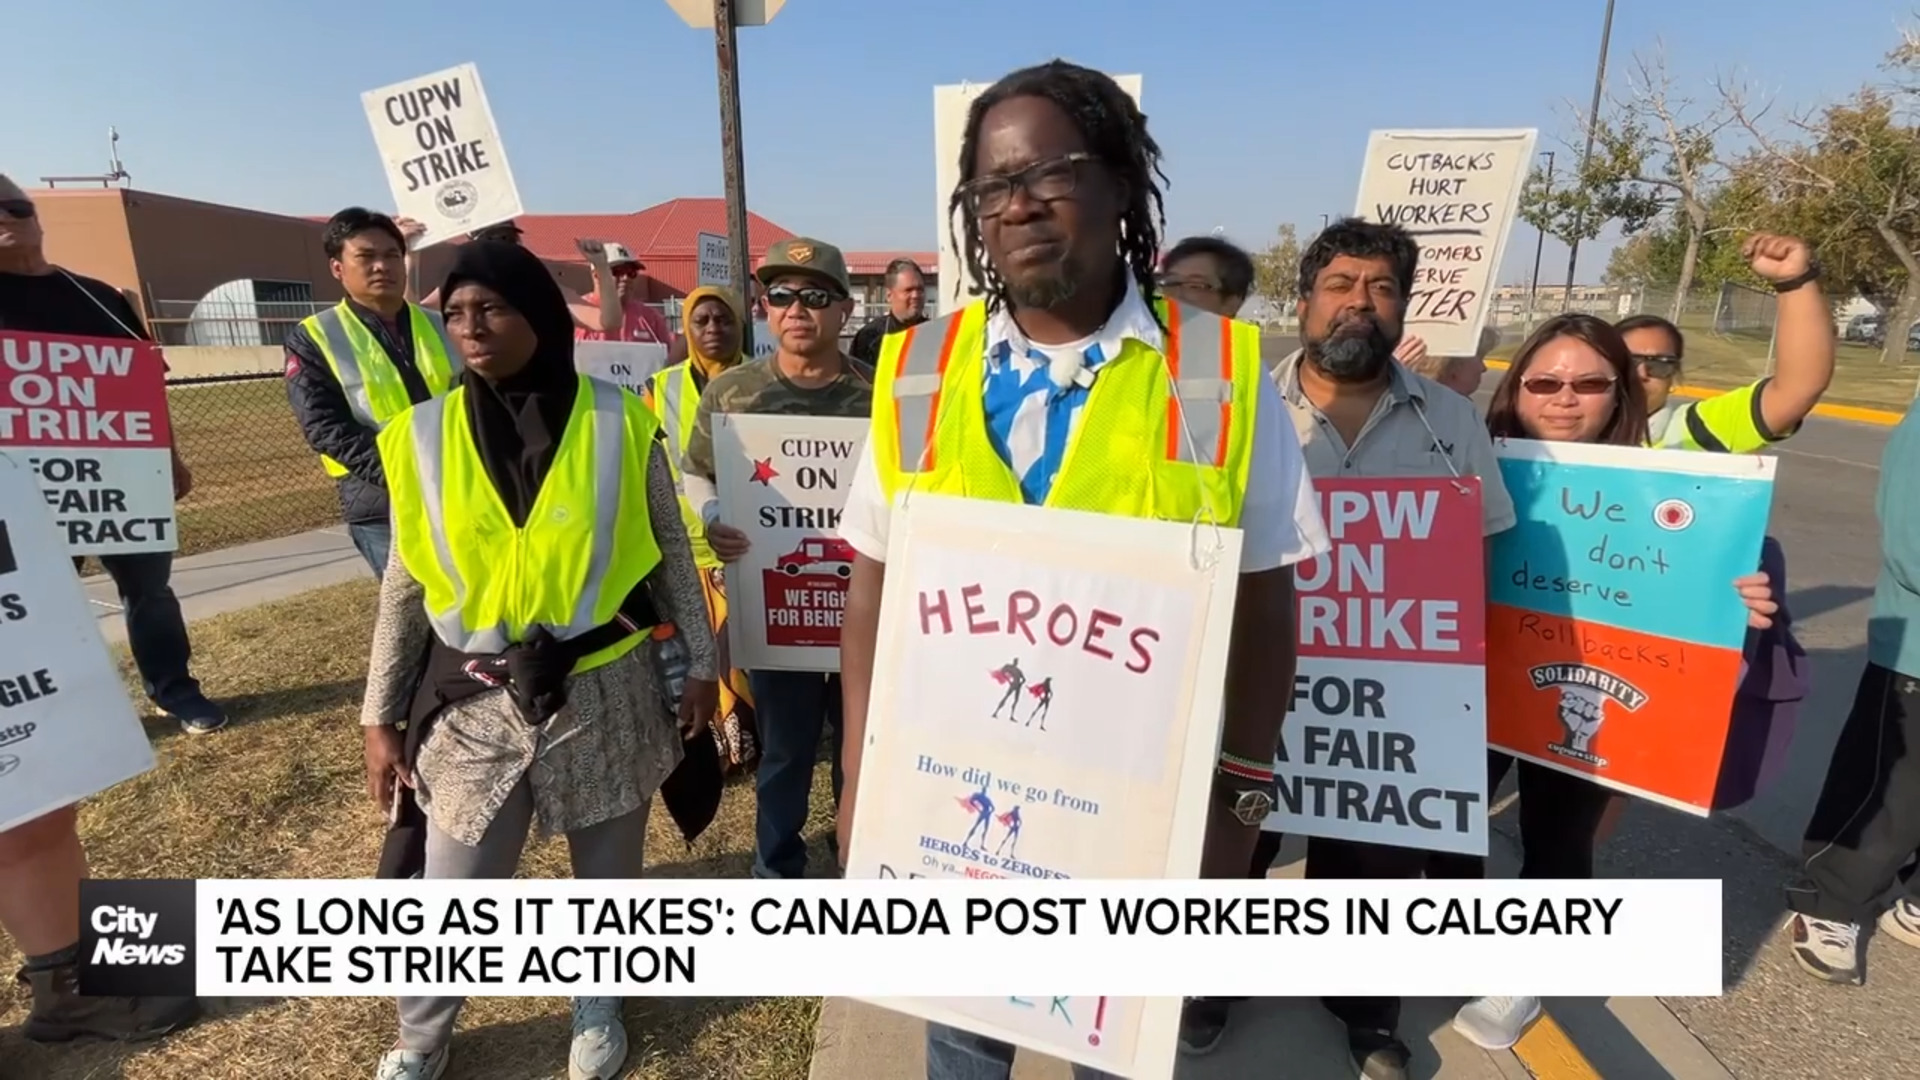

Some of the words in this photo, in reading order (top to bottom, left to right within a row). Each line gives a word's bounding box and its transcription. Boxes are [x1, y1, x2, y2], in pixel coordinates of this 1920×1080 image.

[385, 77, 462, 126] CUPW
[415, 115, 456, 151] ON
[401, 139, 490, 192] STRIKE
[1387, 153, 1495, 173] CUTBACKS
[1409, 178, 1467, 196] HURT
[1376, 203, 1493, 225] WORKERS
[1413, 267, 1469, 285] ERVE
[610, 363, 631, 376] ON
[9, 373, 96, 407] ON
[0, 407, 153, 441] TRIKE
[781, 439, 854, 459] CUPW
[796, 467, 837, 490] ON
[759, 505, 845, 529] STRIK
[1561, 487, 1626, 522] We
[57, 518, 171, 545] RACT
[1294, 544, 1385, 593] ON
[1588, 534, 1670, 575] don't
[785, 589, 811, 607] WE
[1511, 561, 1632, 607] deserve
[768, 608, 800, 626] FOR
[918, 583, 1161, 674] HEROES
[1300, 596, 1460, 652] RIKE
[1288, 675, 1386, 718] FOR
[1533, 666, 1646, 708] SOLIDARITY
[1304, 725, 1417, 774] FAIR
[916, 754, 958, 778] How
[962, 767, 991, 788] did
[998, 778, 1021, 796] we
[1025, 786, 1048, 803] go
[1053, 789, 1100, 815] from
[1271, 773, 1479, 834] NTRACT
[919, 836, 981, 862] HEROES
[983, 854, 999, 867] to
[922, 855, 939, 868] Oh
